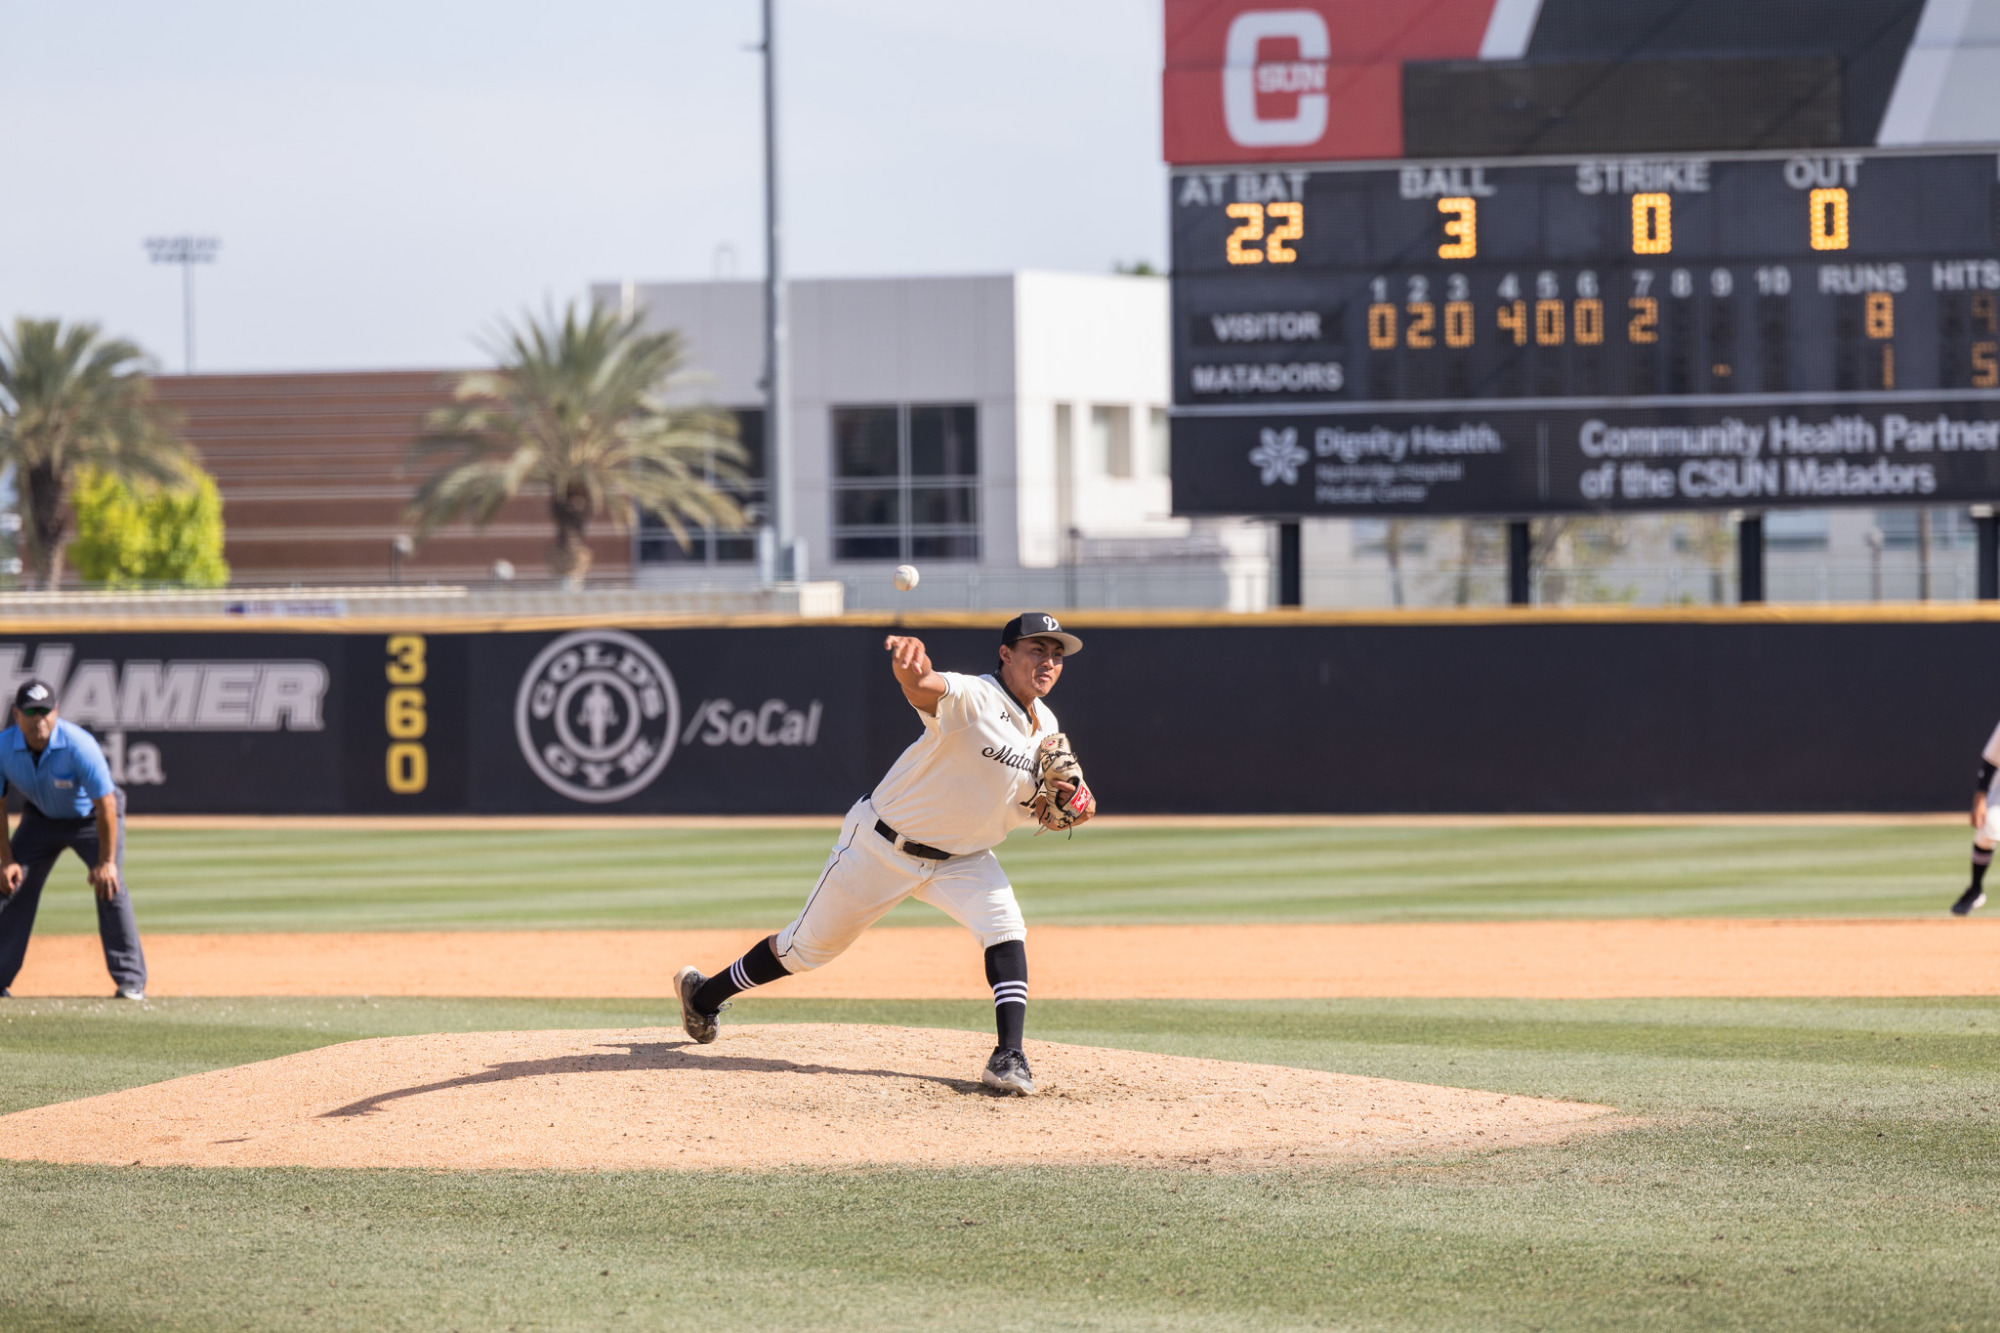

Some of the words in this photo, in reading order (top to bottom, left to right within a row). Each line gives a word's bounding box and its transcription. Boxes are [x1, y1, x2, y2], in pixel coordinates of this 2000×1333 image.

[1180, 174, 1227, 206] AT
[1236, 171, 1310, 203] BAT
[1400, 164, 1497, 198] BALL
[1576, 160, 1711, 194] STRIKE
[1784, 156, 1863, 189] OUT
[1226, 201, 1304, 264] 22
[1437, 197, 1477, 259] 3
[1632, 192, 1672, 254] 0
[1810, 188, 1850, 250] 0
[1370, 276, 1388, 302] 1
[1407, 274, 1430, 302] 2
[1446, 273, 1470, 300] 3
[1498, 272, 1520, 299] 4
[1536, 270, 1559, 299] 5
[1576, 269, 1599, 298] 6
[1632, 269, 1654, 297] 7
[1670, 268, 1693, 298] 8
[1710, 267, 1733, 297] 9
[1755, 266, 1791, 295] 10
[1818, 262, 1907, 293] RUNS
[1932, 259, 2000, 290] HITS
[1211, 311, 1322, 342] VISITOR
[1368, 302, 1397, 350] 0
[1406, 302, 1435, 349] 2
[1444, 301, 1475, 349] 0
[1497, 299, 1527, 347] 4
[1535, 298, 1566, 346] 0
[1573, 298, 1604, 346] 0
[1627, 296, 1659, 344] 2
[1192, 362, 1344, 394] MATADORS
[1971, 341, 1998, 388] 5
[1314, 425, 1409, 463] Dignity
[1410, 422, 1501, 455] Health
[1579, 417, 1764, 458] Community
[1769, 414, 1876, 454] Health
[1580, 462, 1618, 498] of
[1620, 461, 1676, 498] the
[1678, 459, 1779, 497] CSUN
[1784, 457, 1937, 495] Matadors
[682, 698, 823, 746] /SoCal
[543, 735, 655, 788] GYM
